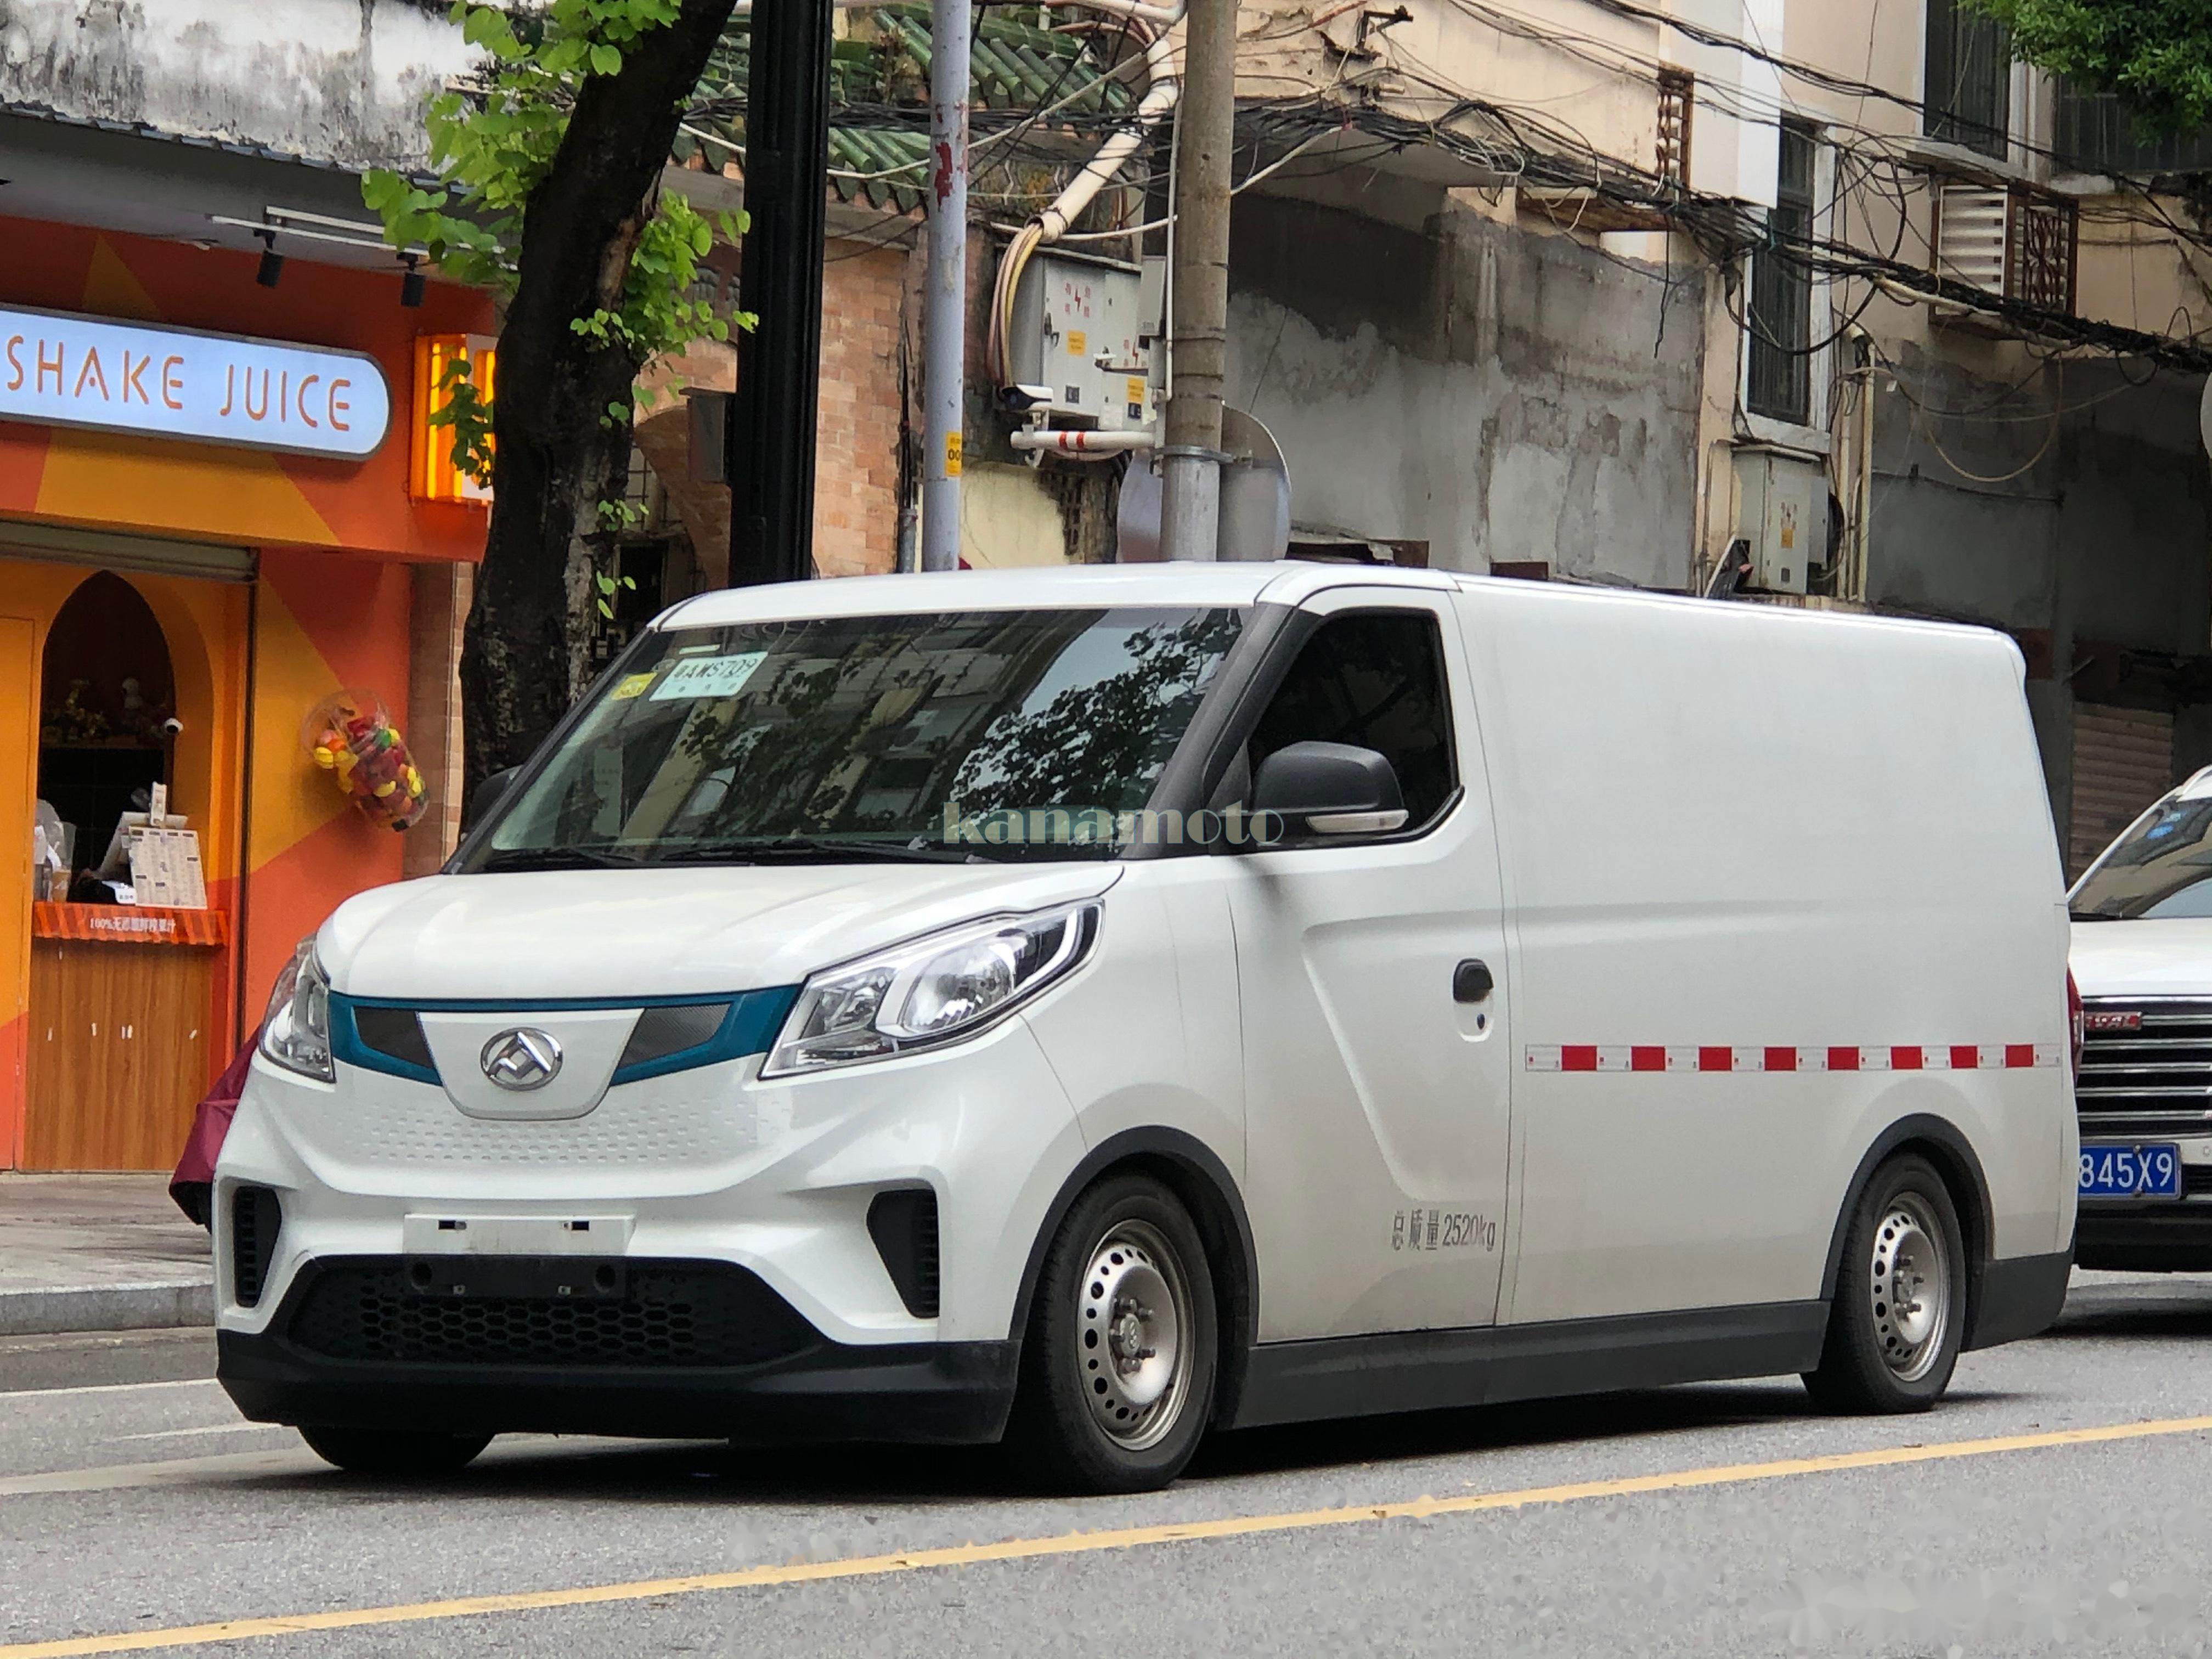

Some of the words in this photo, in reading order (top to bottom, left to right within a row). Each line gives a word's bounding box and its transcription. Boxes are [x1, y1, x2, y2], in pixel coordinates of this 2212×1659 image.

[7, 335, 183, 410] SHAKE
[219, 363, 351, 432] JUICE
[2079, 1152, 2173, 1192] 845X9
[1391, 1209, 1496, 1252] 总质量2520kg
